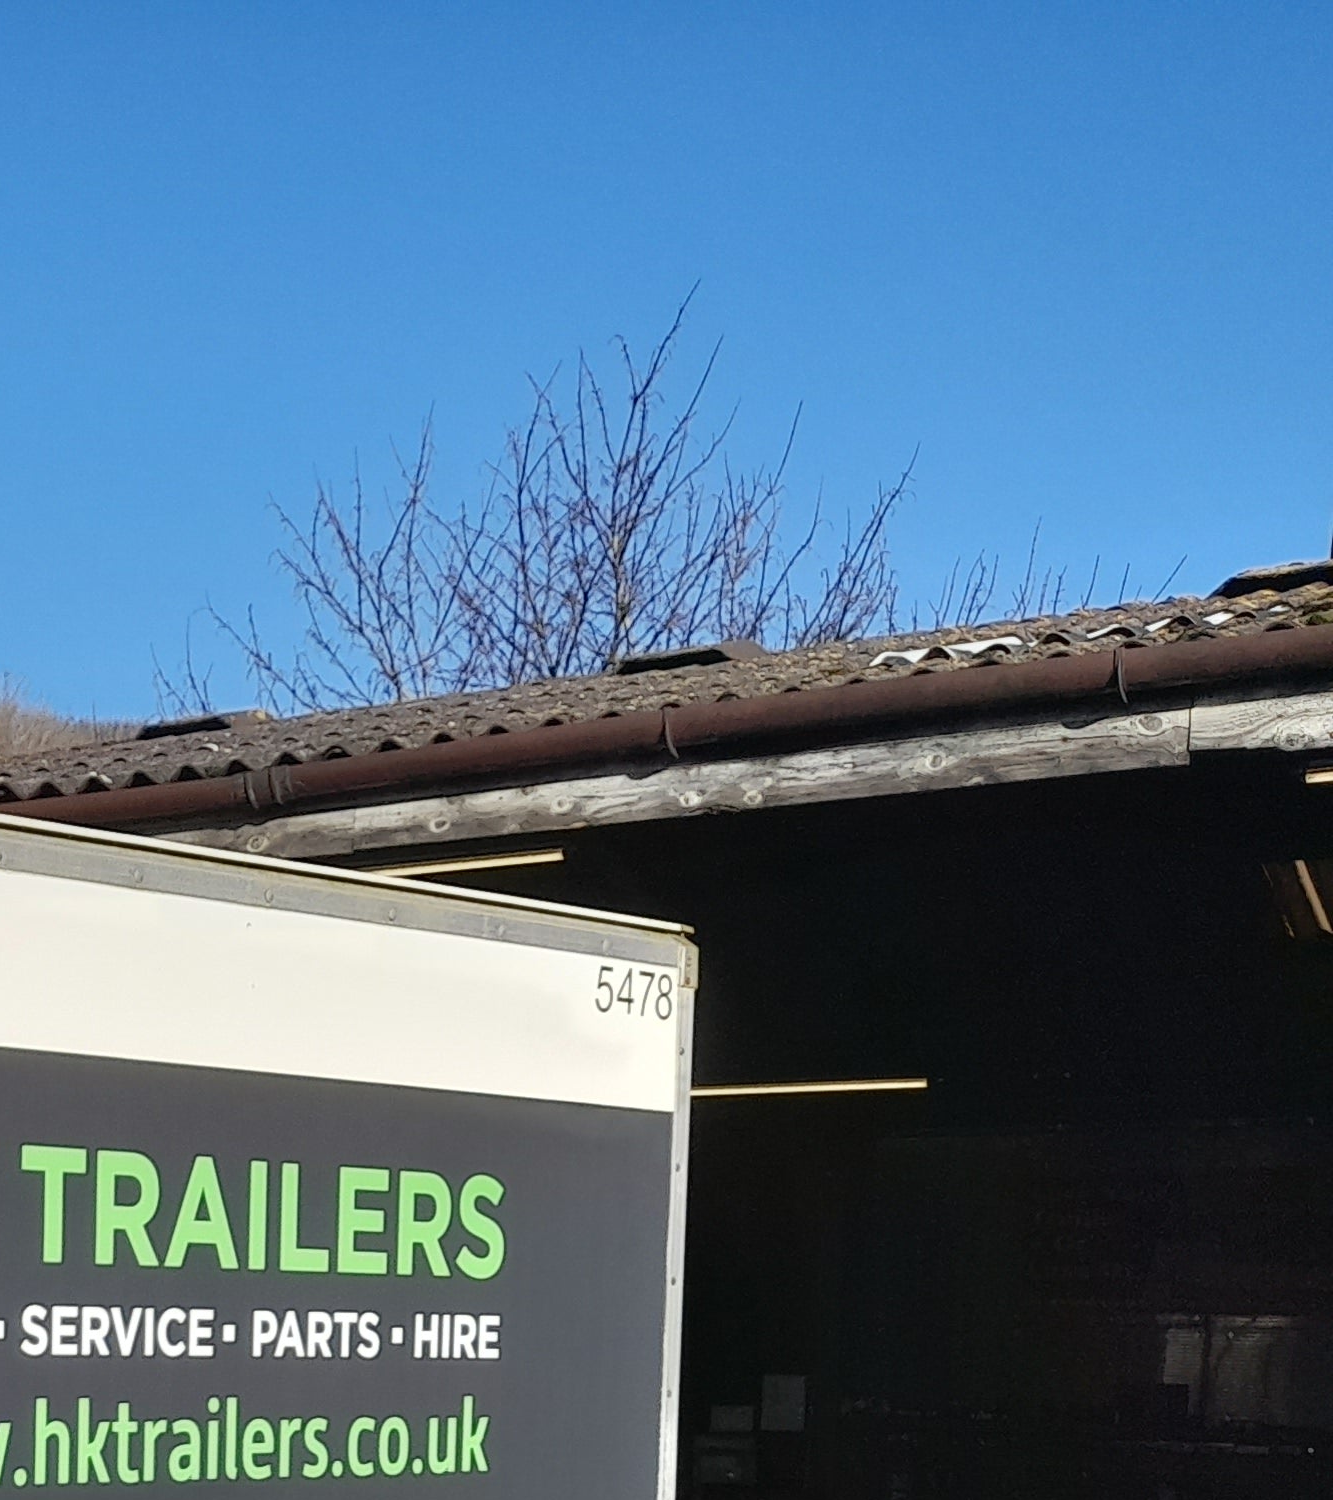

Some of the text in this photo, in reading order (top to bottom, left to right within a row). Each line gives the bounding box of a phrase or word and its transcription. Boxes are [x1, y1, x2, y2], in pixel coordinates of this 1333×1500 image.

[595, 965, 673, 1021] 5478
[20, 1143, 506, 1280] TRAILERS
[19, 1304, 215, 1359] SERVICE
[252, 1309, 381, 1360] PARTS
[413, 1313, 502, 1360] HIRE
